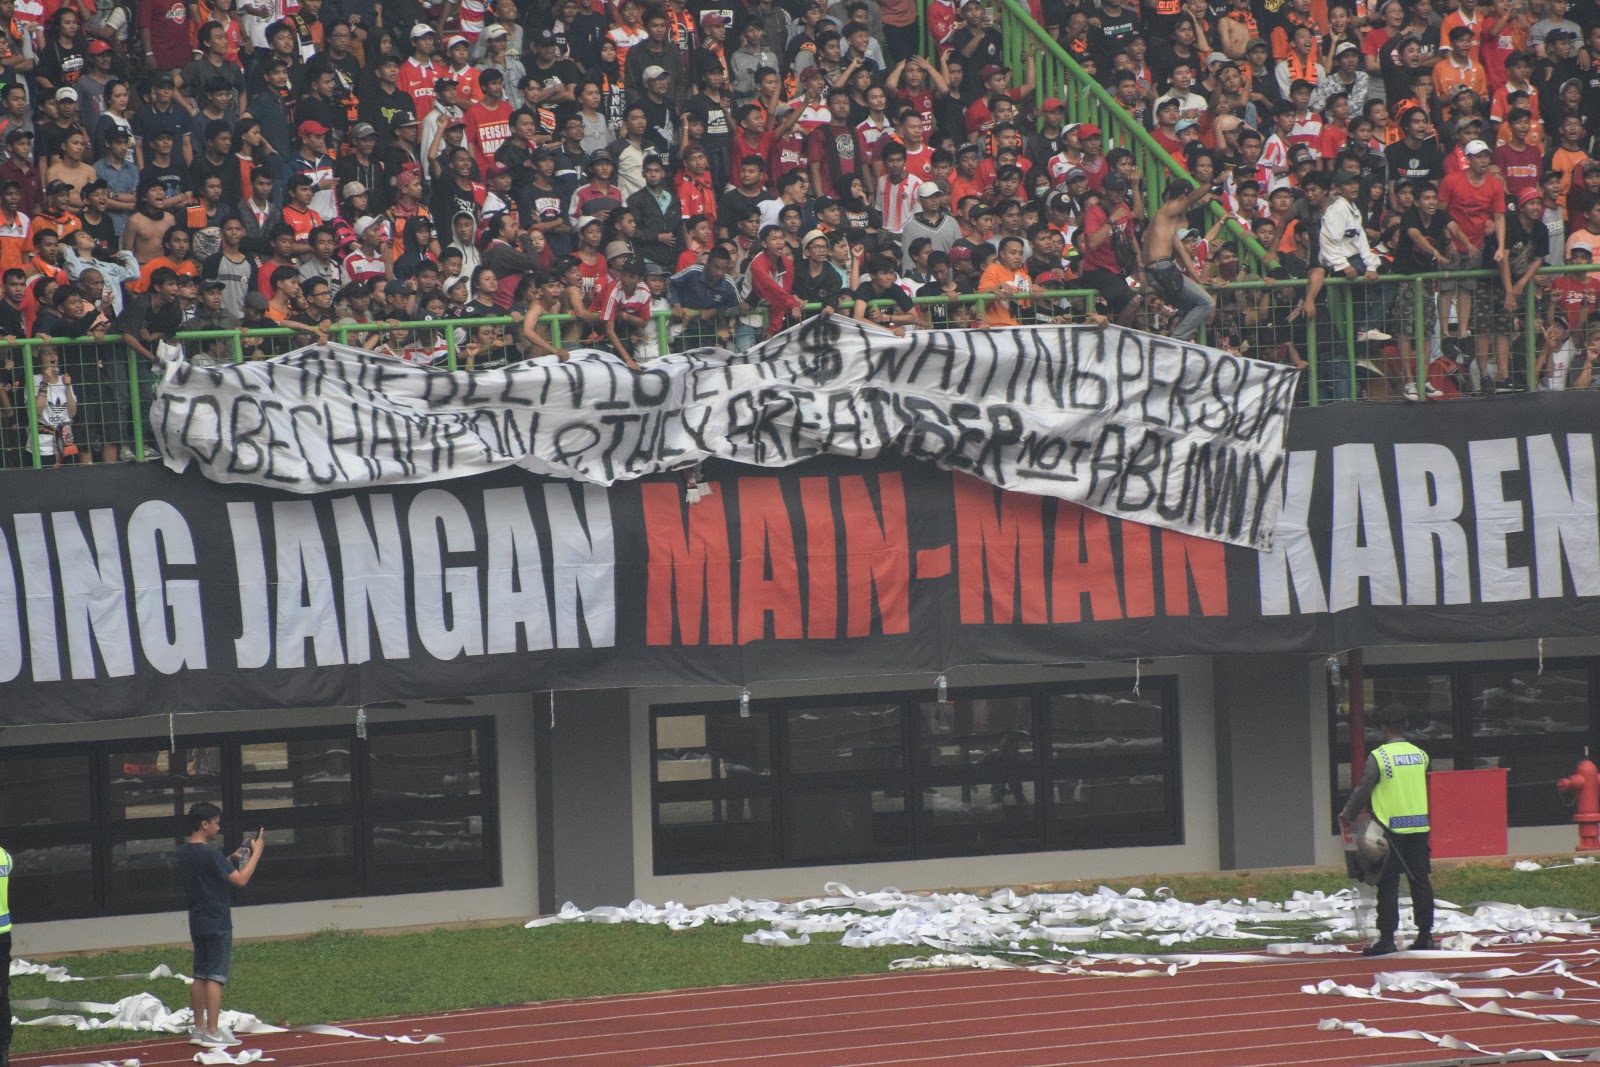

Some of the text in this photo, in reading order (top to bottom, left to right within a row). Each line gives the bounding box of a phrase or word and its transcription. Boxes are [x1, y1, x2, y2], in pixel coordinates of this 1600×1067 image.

[479, 124, 512, 140] PERSIJA
[482, 139, 505, 154] JAKA
[855, 323, 1108, 409] WAITING
[1108, 328, 1300, 450] PERSIJA
[160, 393, 222, 466] TO
[227, 393, 300, 484] BE
[289, 403, 540, 485] CHAMPION
[1016, 431, 1092, 476] NOT
[1116, 428, 1284, 544] BUNNY
[226, 483, 615, 669] JANGAN
[1257, 432, 1600, 616] KAREN
[1394, 754, 1423, 766] POLISI
